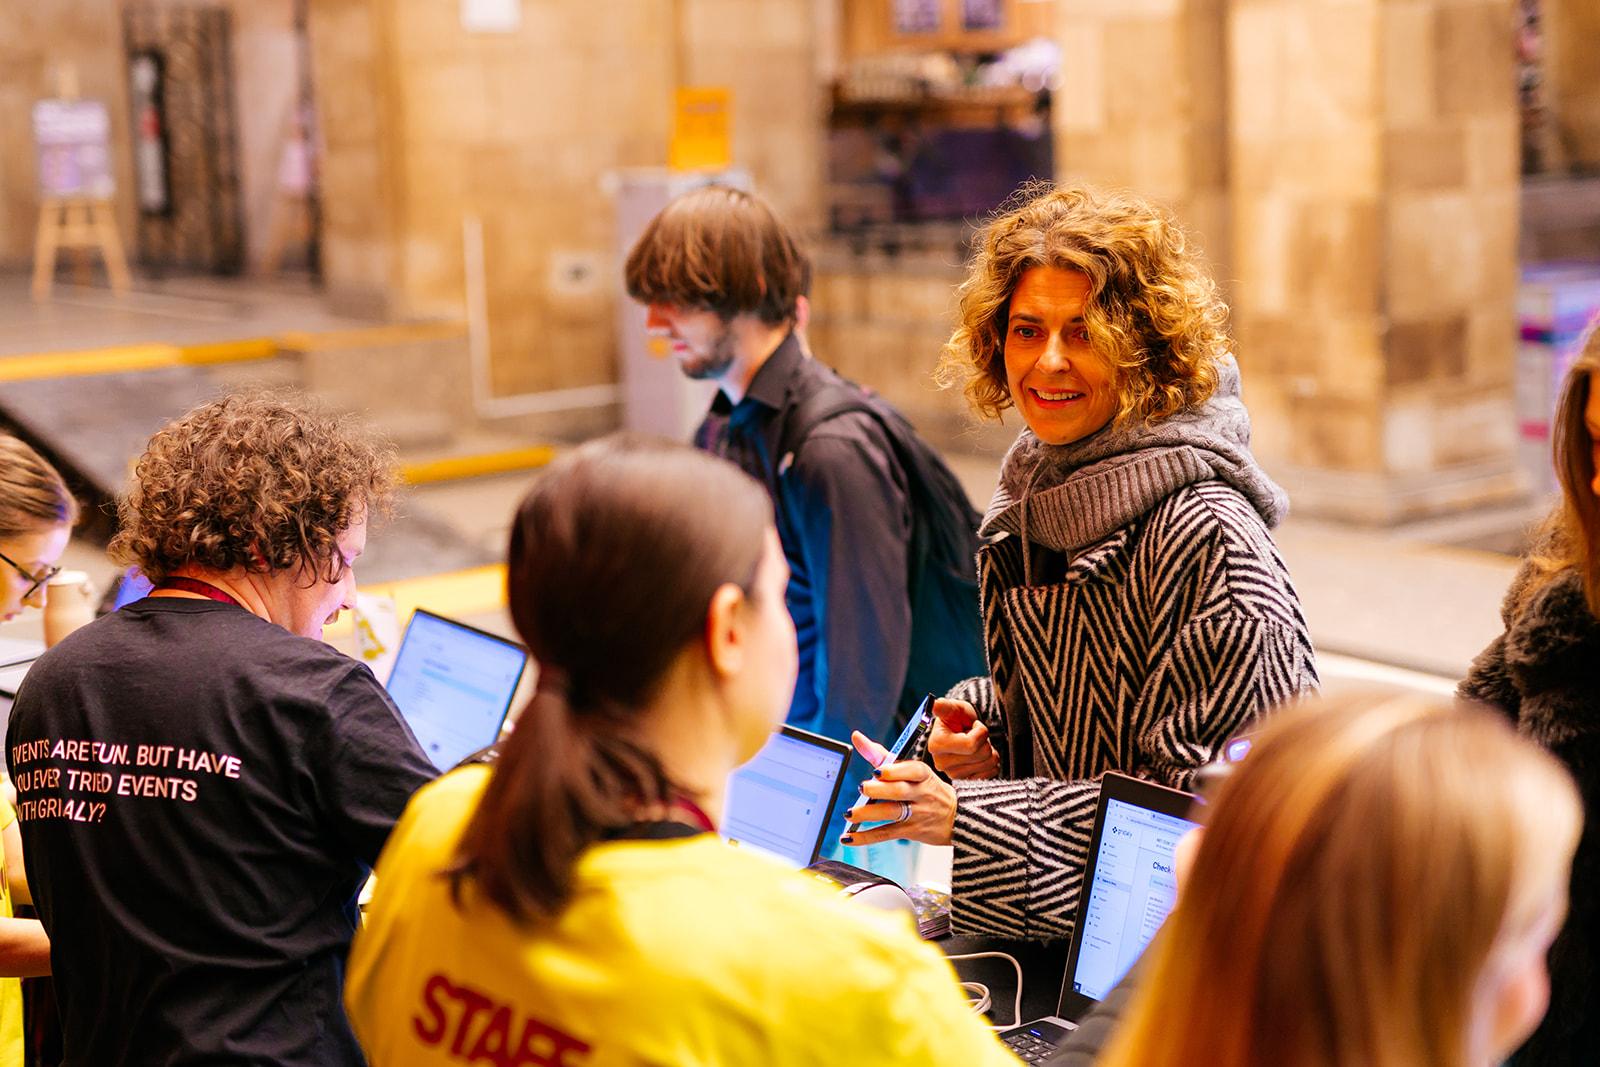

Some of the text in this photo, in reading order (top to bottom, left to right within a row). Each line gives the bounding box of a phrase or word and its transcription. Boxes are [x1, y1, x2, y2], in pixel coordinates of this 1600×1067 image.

[50, 739, 90, 761] ARE
[91, 741, 131, 765] FUN.
[136, 745, 174, 767] BUT
[177, 748, 242, 779] HAVE
[15, 768, 198, 802] OU EVER TRIED EVENTS
